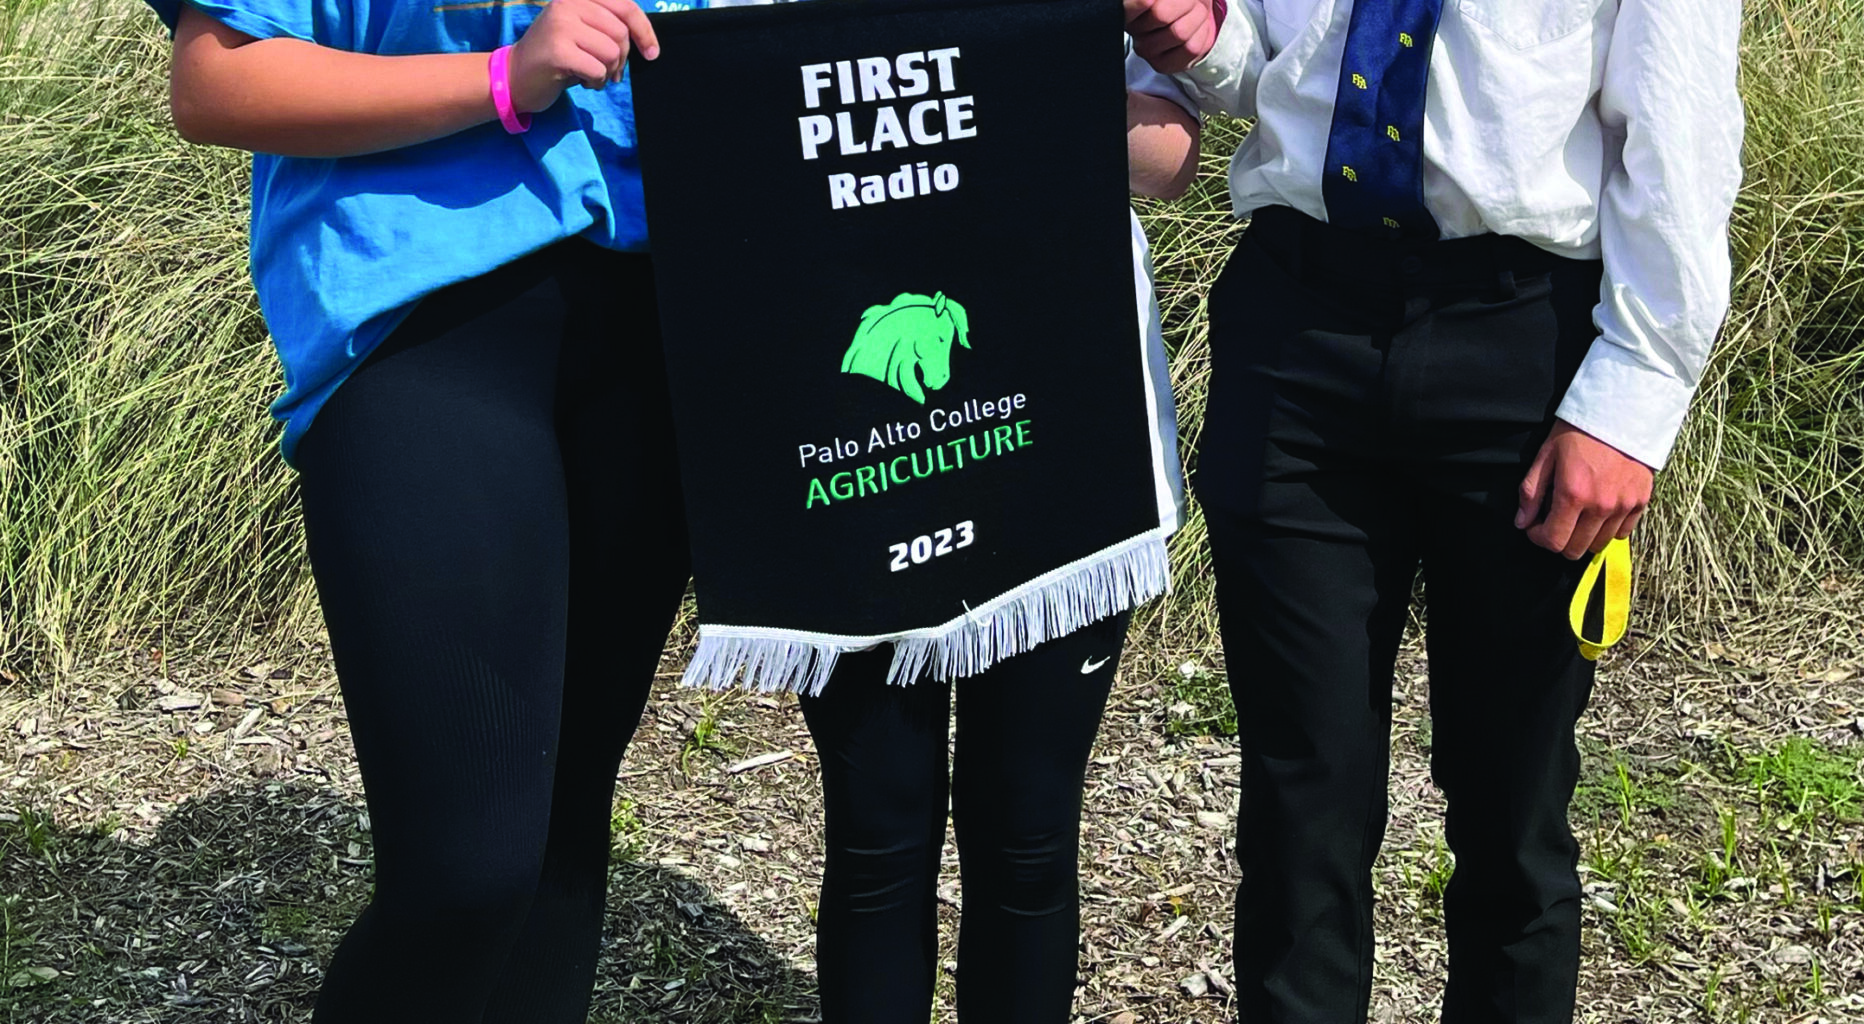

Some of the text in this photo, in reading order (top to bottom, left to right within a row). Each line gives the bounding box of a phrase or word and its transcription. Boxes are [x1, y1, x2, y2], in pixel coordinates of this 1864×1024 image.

[800, 46, 961, 109] FIRST
[798, 95, 978, 160] PLACE
[827, 161, 960, 210] Radio
[798, 392, 1028, 468] Palo Alto College
[805, 419, 1034, 510] AGRICULTURE
[888, 519, 975, 573] 2023
